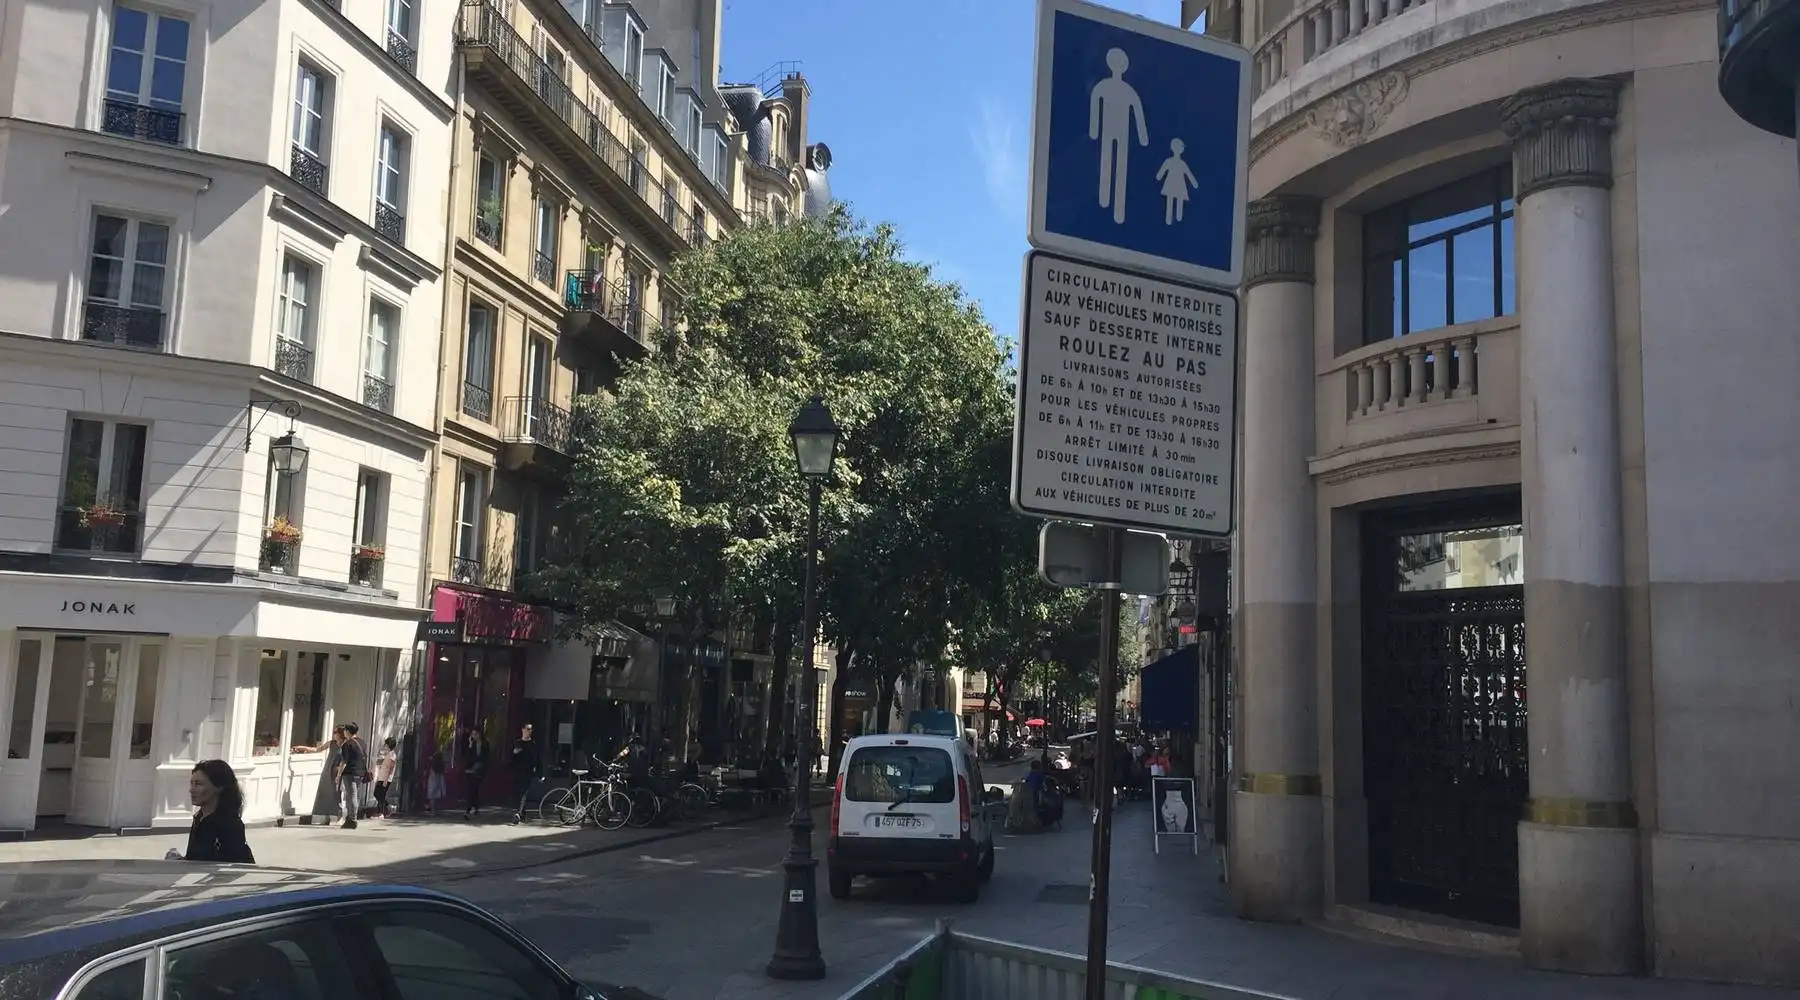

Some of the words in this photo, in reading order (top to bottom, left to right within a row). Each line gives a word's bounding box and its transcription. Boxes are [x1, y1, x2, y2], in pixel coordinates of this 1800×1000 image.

[1047, 268, 1143, 300] CIRCULATION
[1150, 290, 1223, 317] INTERDITE
[1045, 289, 1071, 307] AUX
[1078, 295, 1148, 322] VÉHICULES
[1152, 311, 1223, 336] MOTORISÉS
[1044, 311, 1081, 329] SAUF
[1089, 319, 1159, 345] DESSERTE
[1166, 335, 1222, 357] INTERNE
[1059, 335, 1131, 363] ROULEZ
[1142, 352, 1165, 369] AU
[1176, 357, 1207, 377] PAS
[1040, 374, 1054, 386] DE
[1060, 378, 1073, 389] 6h
[1091, 383, 1108, 395] 10h
[1113, 387, 1125, 398] ET
[1130, 390, 1143, 401] DE
[1148, 393, 1176, 406] 13h30
[1193, 401, 1221, 415] 15h30
[1063, 360, 1130, 381] LIVRAISONS
[1136, 373, 1202, 394] AUTORISÉES
[1039, 412, 1053, 423] DE
[1058, 414, 1071, 426] 6h
[1090, 420, 1104, 431] 11h
[1110, 423, 1122, 433] ET
[1127, 426, 1140, 437] DE
[1146, 429, 1174, 442] 13h30
[1192, 436, 1220, 450] 16h30
[1040, 393, 1071, 408] POUR
[1078, 398, 1098, 411] LES
[1105, 402, 1166, 423] VÉHICULES
[1172, 415, 1220, 432] PROPRES
[1065, 434, 1101, 449] ARRÊT
[1108, 442, 1145, 456] LIMITÉ
[1036, 449, 1079, 465] DISQUE
[1086, 458, 1145, 475] LIVRAISON
[1151, 467, 1219, 485] OBLIGATOIRE
[1035, 487, 1056, 499] AUX
[1063, 489, 1121, 508] VÉHICULES
[1126, 499, 1140, 510] DE
[1144, 502, 1170, 514] PLUS
[1175, 506, 1188, 516] DE
[1061, 472, 1134, 491] CIRCULATION
[1140, 483, 1196, 500] INTERDITE
[60, 600, 136, 615] JONAK
[881, 816, 895, 827] 457
[912, 818, 922, 827] 75
